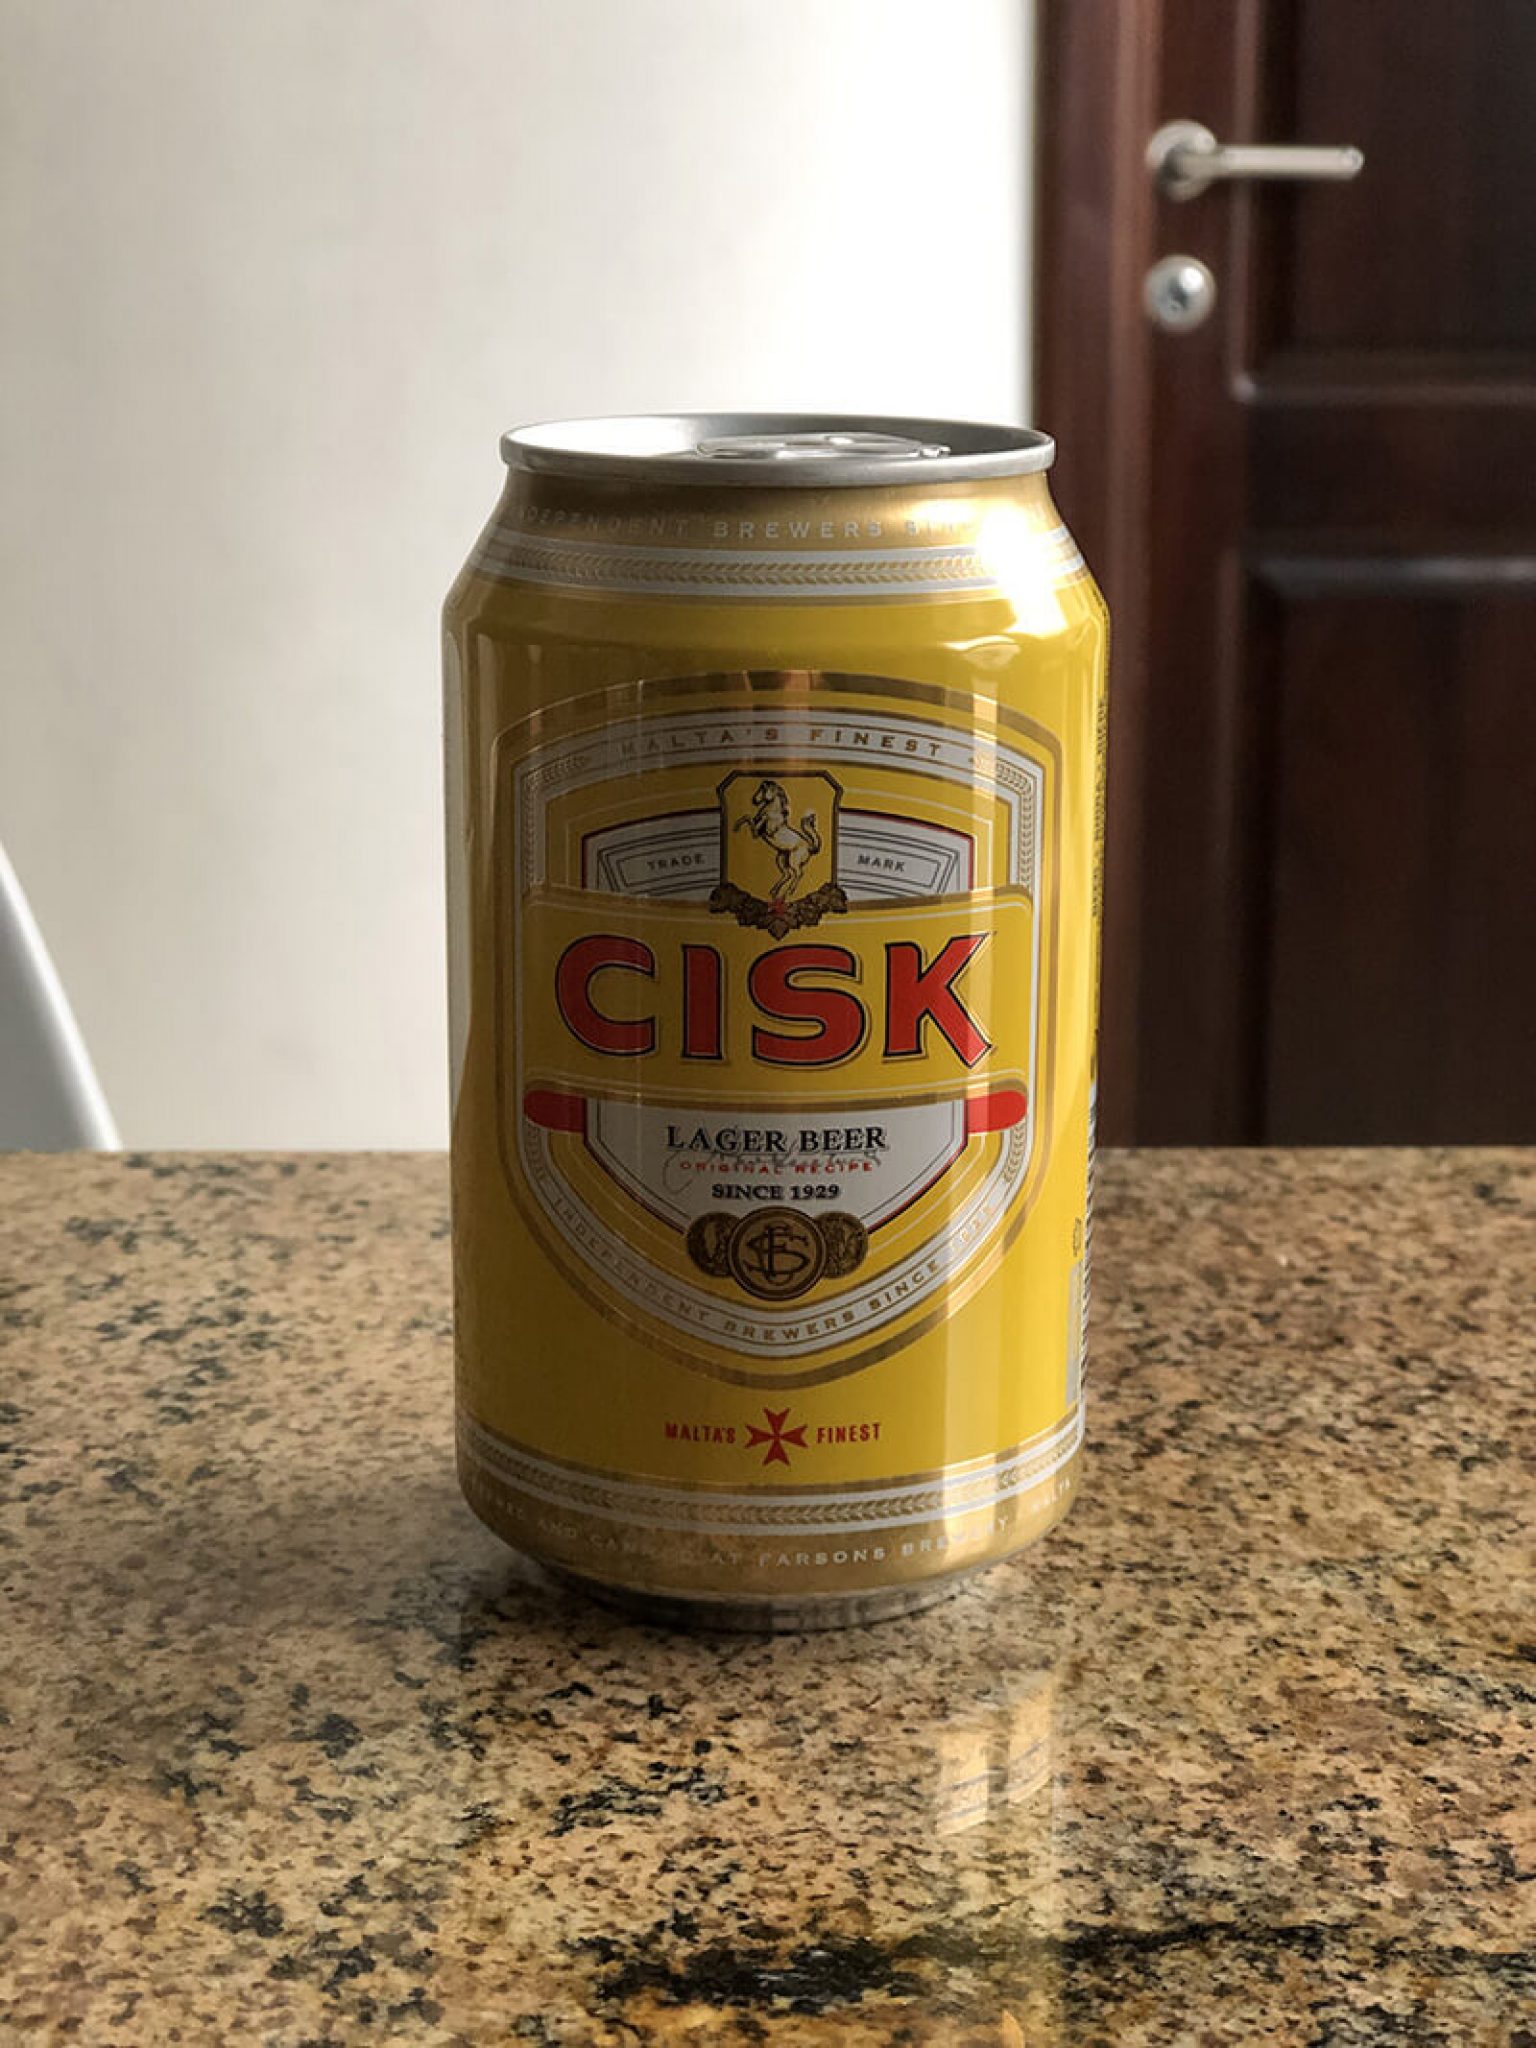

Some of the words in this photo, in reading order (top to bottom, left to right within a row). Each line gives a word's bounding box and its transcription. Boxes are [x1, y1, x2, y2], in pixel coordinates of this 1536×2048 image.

[712, 520, 883, 539] BREWERS
[620, 727, 780, 757] MALTA'S
[809, 728, 942, 757] FINEST
[647, 853, 705, 871] TRADE
[857, 853, 906, 873] MARK
[554, 932, 998, 1071] CISK
[666, 1125, 786, 1152] LAGER
[798, 1125, 887, 1152] BEER
[680, 1160, 782, 1175] ORIGINAL
[794, 1159, 874, 1175] RECIPE
[711, 1183, 783, 1200] SINCE
[790, 1183, 841, 1200] 1929
[723, 1312, 855, 1341] BREWERS
[868, 1259, 938, 1310] SINCE
[664, 1422, 737, 1445] MALTA'S
[816, 1422, 882, 1444] FINEST
[759, 1546, 887, 1567] FARSONS
